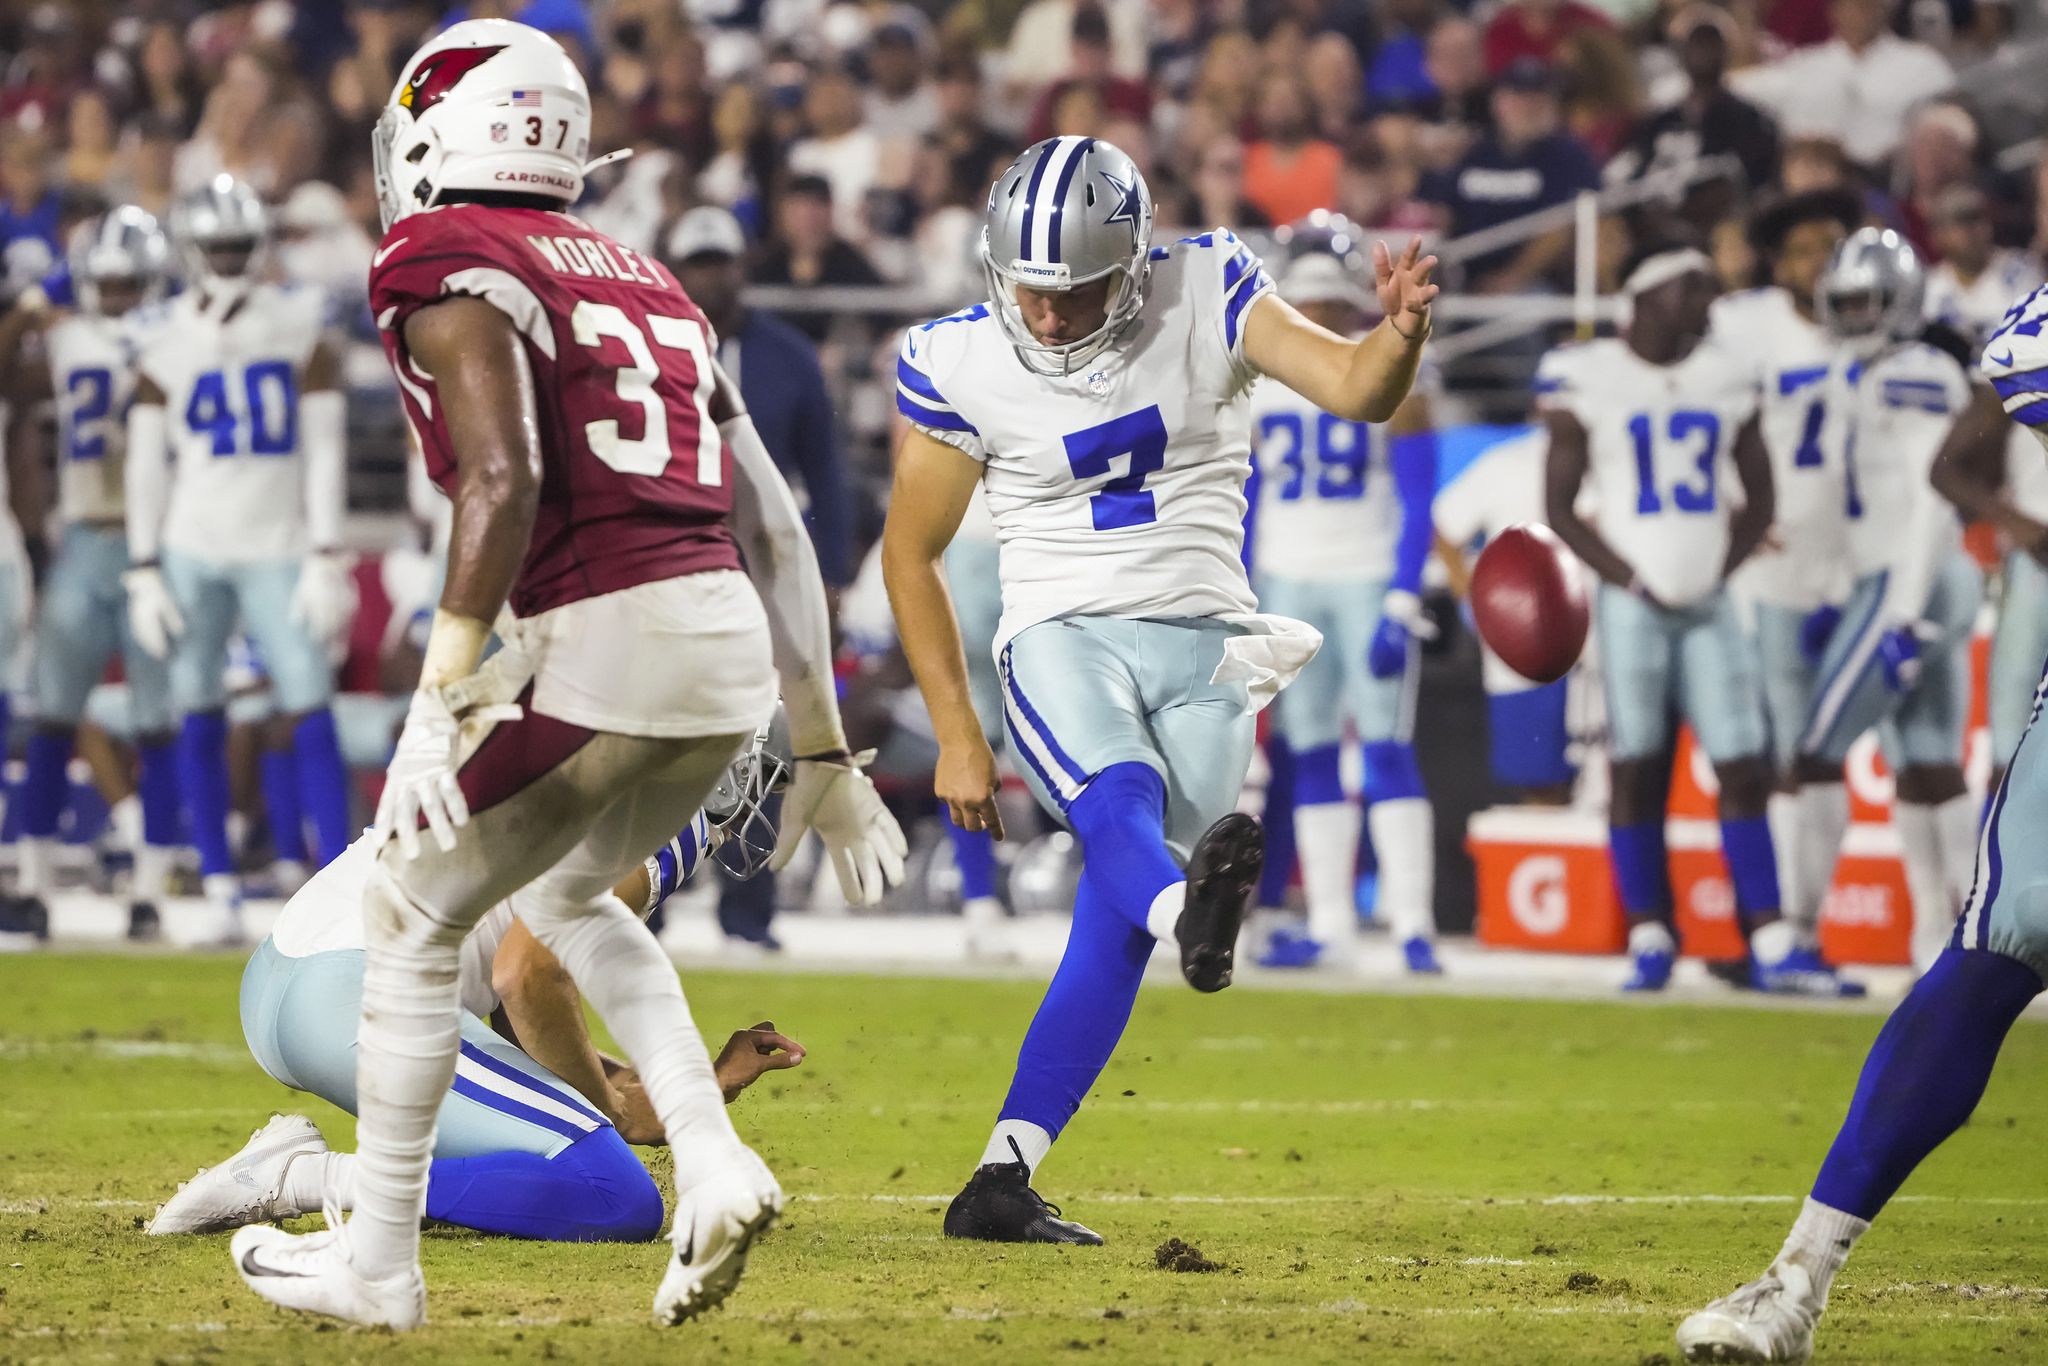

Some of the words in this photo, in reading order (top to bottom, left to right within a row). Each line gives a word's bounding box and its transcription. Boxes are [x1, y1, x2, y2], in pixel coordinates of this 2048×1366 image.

[495, 171, 574, 190] CARDINALS
[526, 235, 669, 289] WORLEY
[1023, 266, 1056, 276] COWBOYS
[67, 365, 133, 460] 2
[186, 360, 298, 456] 40
[570, 300, 722, 488] 37
[1062, 403, 1169, 531] 7
[1258, 411, 1369, 500] 39
[1628, 409, 1720, 515] 13
[1507, 854, 1570, 935] G
